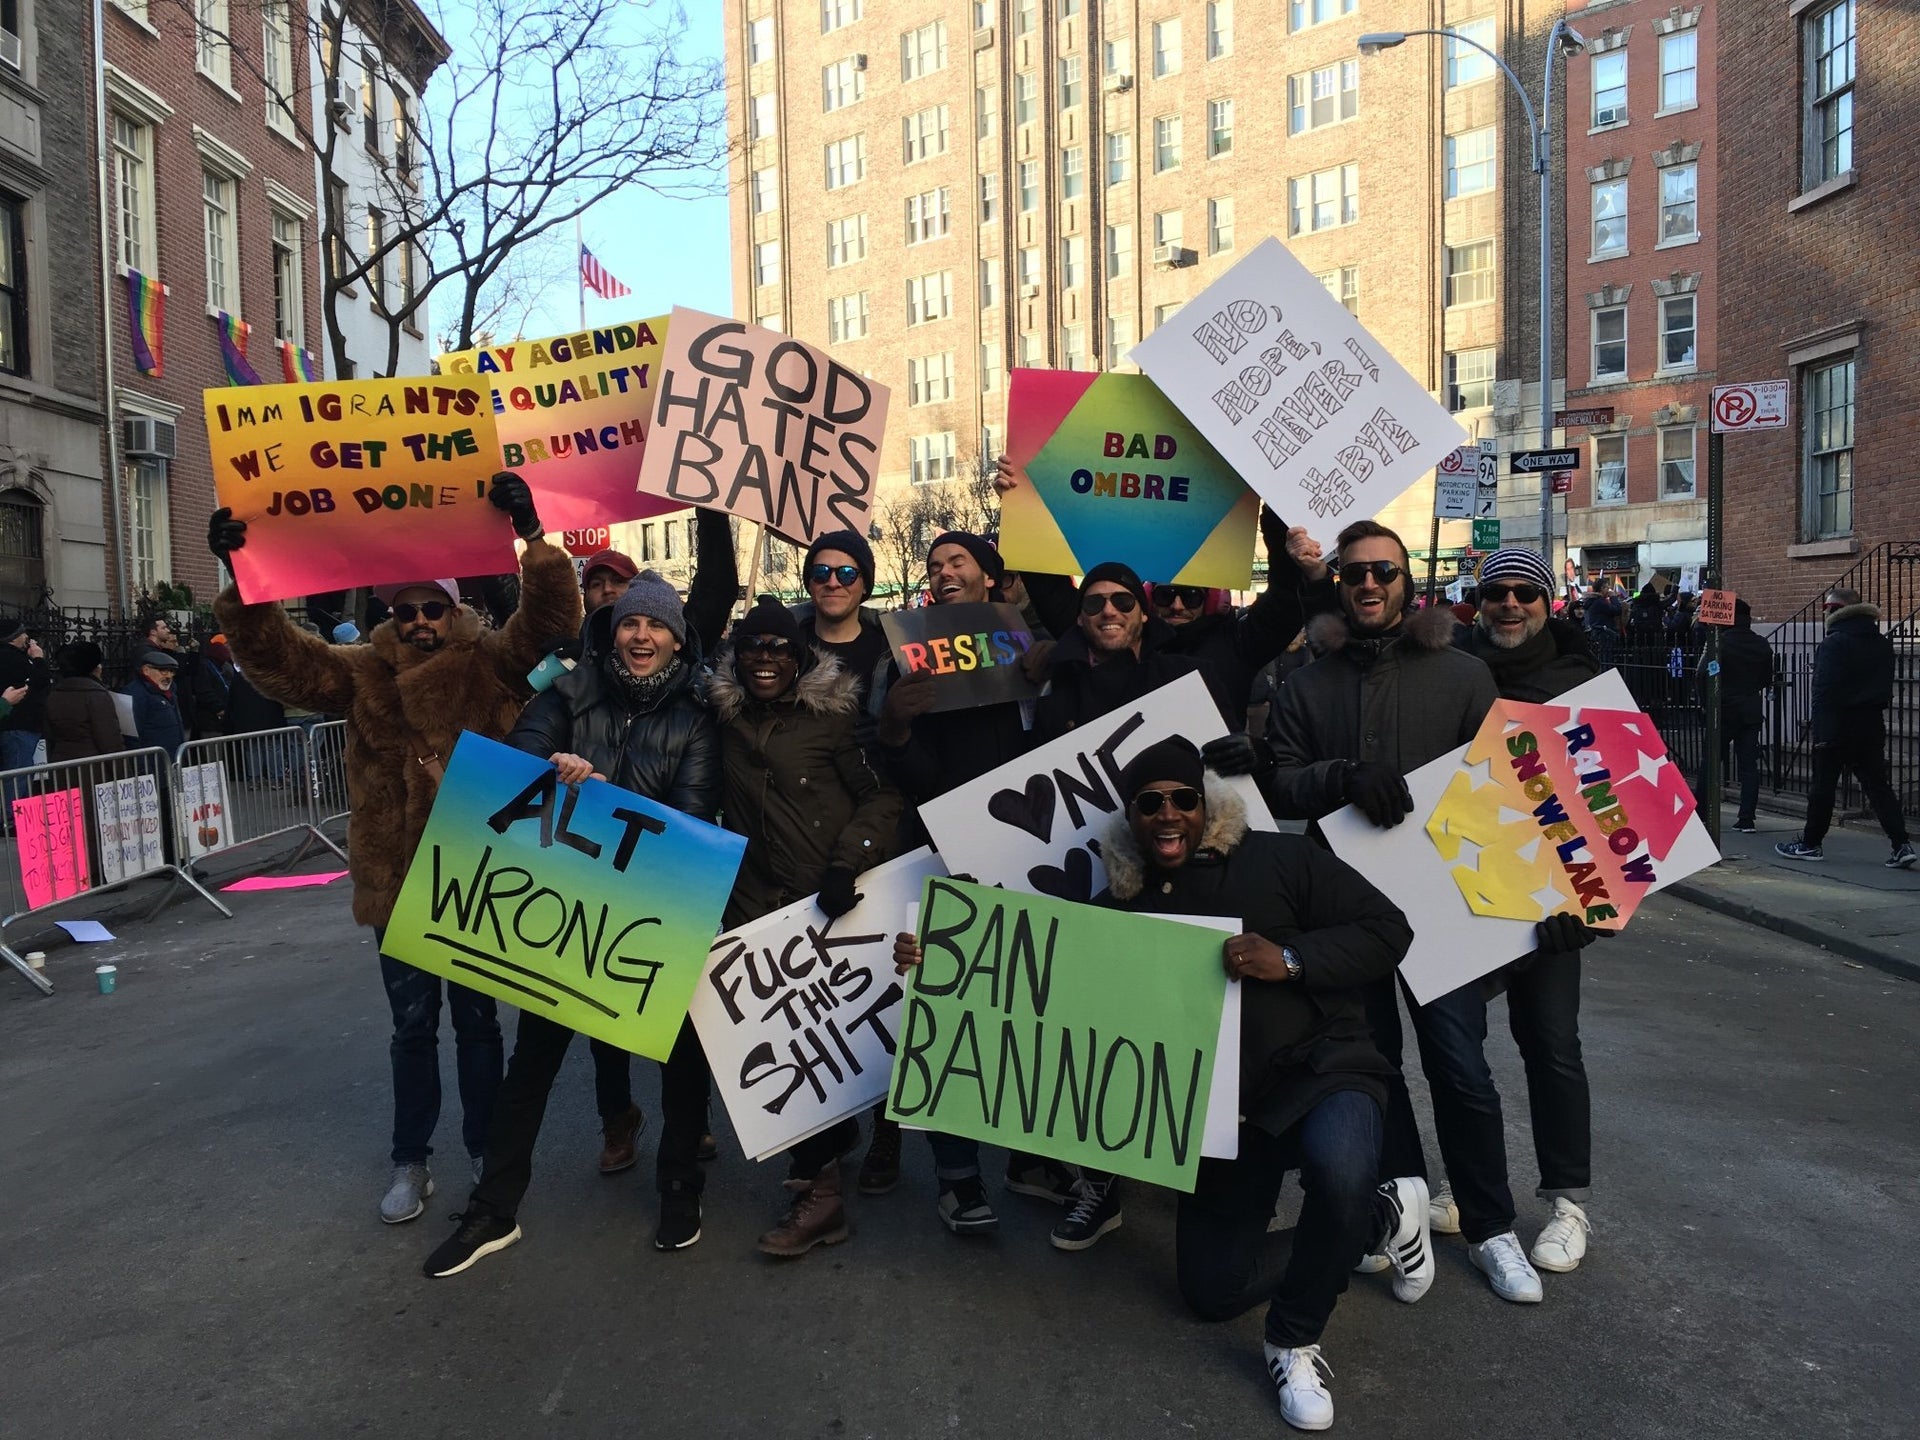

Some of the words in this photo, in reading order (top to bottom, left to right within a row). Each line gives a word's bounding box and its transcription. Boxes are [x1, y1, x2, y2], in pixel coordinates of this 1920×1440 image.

[450, 347, 515, 374] GAY
[529, 322, 658, 369] AGENDA
[1193, 299, 1283, 365] NO,
[688, 323, 872, 424] GOD
[1211, 329, 1322, 425] NOPE,
[1251, 338, 1380, 470] NEVER!
[1558, 415, 1597, 427] STONEWALL
[1600, 414, 1610, 423] PL
[229, 442, 285, 482] WE
[310, 439, 387, 469] GET
[402, 428, 480, 462] THE
[503, 419, 644, 468] BRUNCH
[657, 369, 877, 497] HATES
[1103, 431, 1178, 460] BAD
[1483, 441, 1492, 451] TO
[1070, 468, 1190, 502] OMBRE
[1299, 407, 1420, 519] #BYE
[1438, 481, 1476, 490] MOTORCYCLE
[1480, 462, 1495, 480] 9A
[1523, 457, 1543, 467] ONE
[1549, 455, 1570, 464] WAY
[266, 487, 337, 516] JOB
[566, 527, 608, 546] STOP
[1482, 536, 1498, 544] SOUTH
[1606, 561, 1619, 569] 39
[1701, 610, 1733, 620] SATURDAY
[1703, 600, 1733, 611] PARKING
[900, 630, 1031, 675] RESIST
[487, 769, 667, 873] ALT
[1506, 730, 1619, 925] SNOWFLAKE
[1563, 722, 1656, 882] RAINBOW
[431, 845, 665, 1015] WRONG
[912, 879, 1059, 1017] BAN
[709, 917, 888, 1025] FUCK
[761, 958, 873, 1031] THIS
[740, 982, 903, 1115] SHIT
[892, 996, 1202, 1167] BANNON
